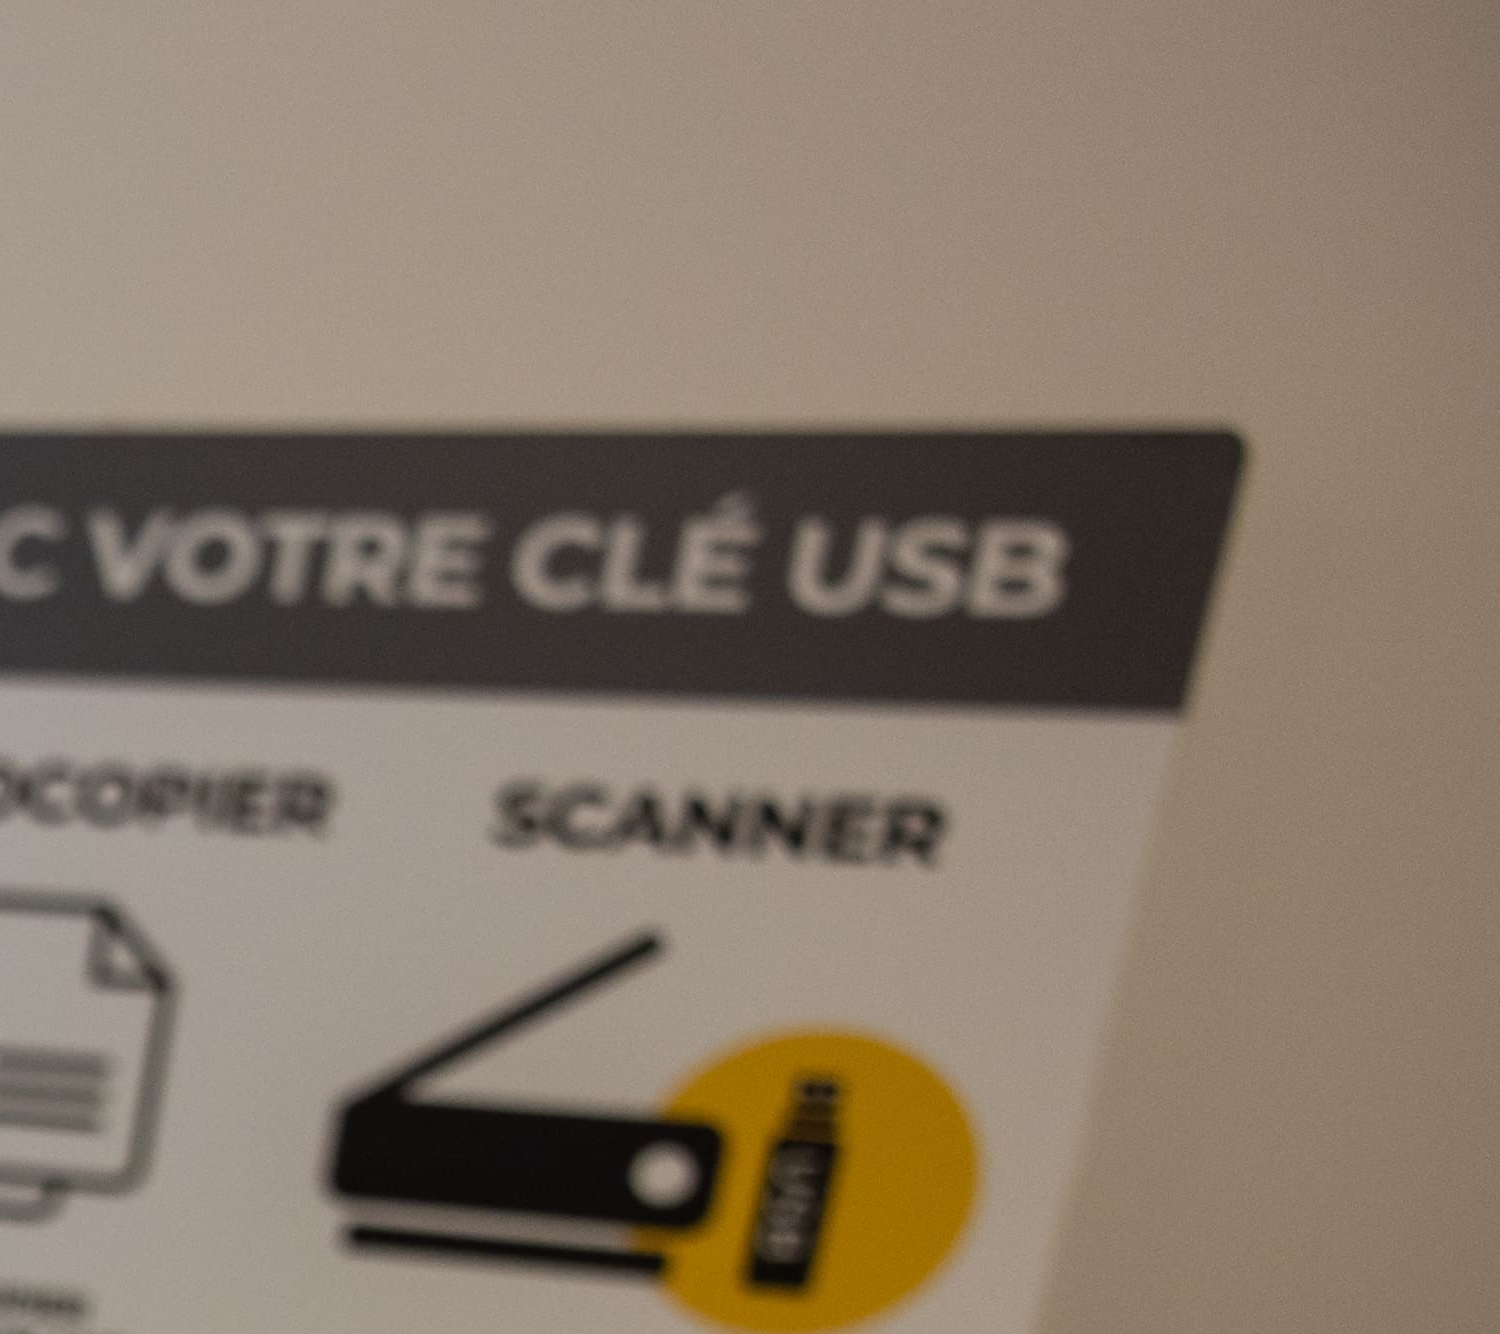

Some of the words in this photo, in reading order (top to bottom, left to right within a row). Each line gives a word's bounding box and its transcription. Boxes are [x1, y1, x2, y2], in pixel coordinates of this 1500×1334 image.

[91, 510, 491, 608] VOTRE
[510, 495, 762, 614] CLÉ
[785, 517, 1070, 620] USB
[490, 781, 946, 867] SCANNER
